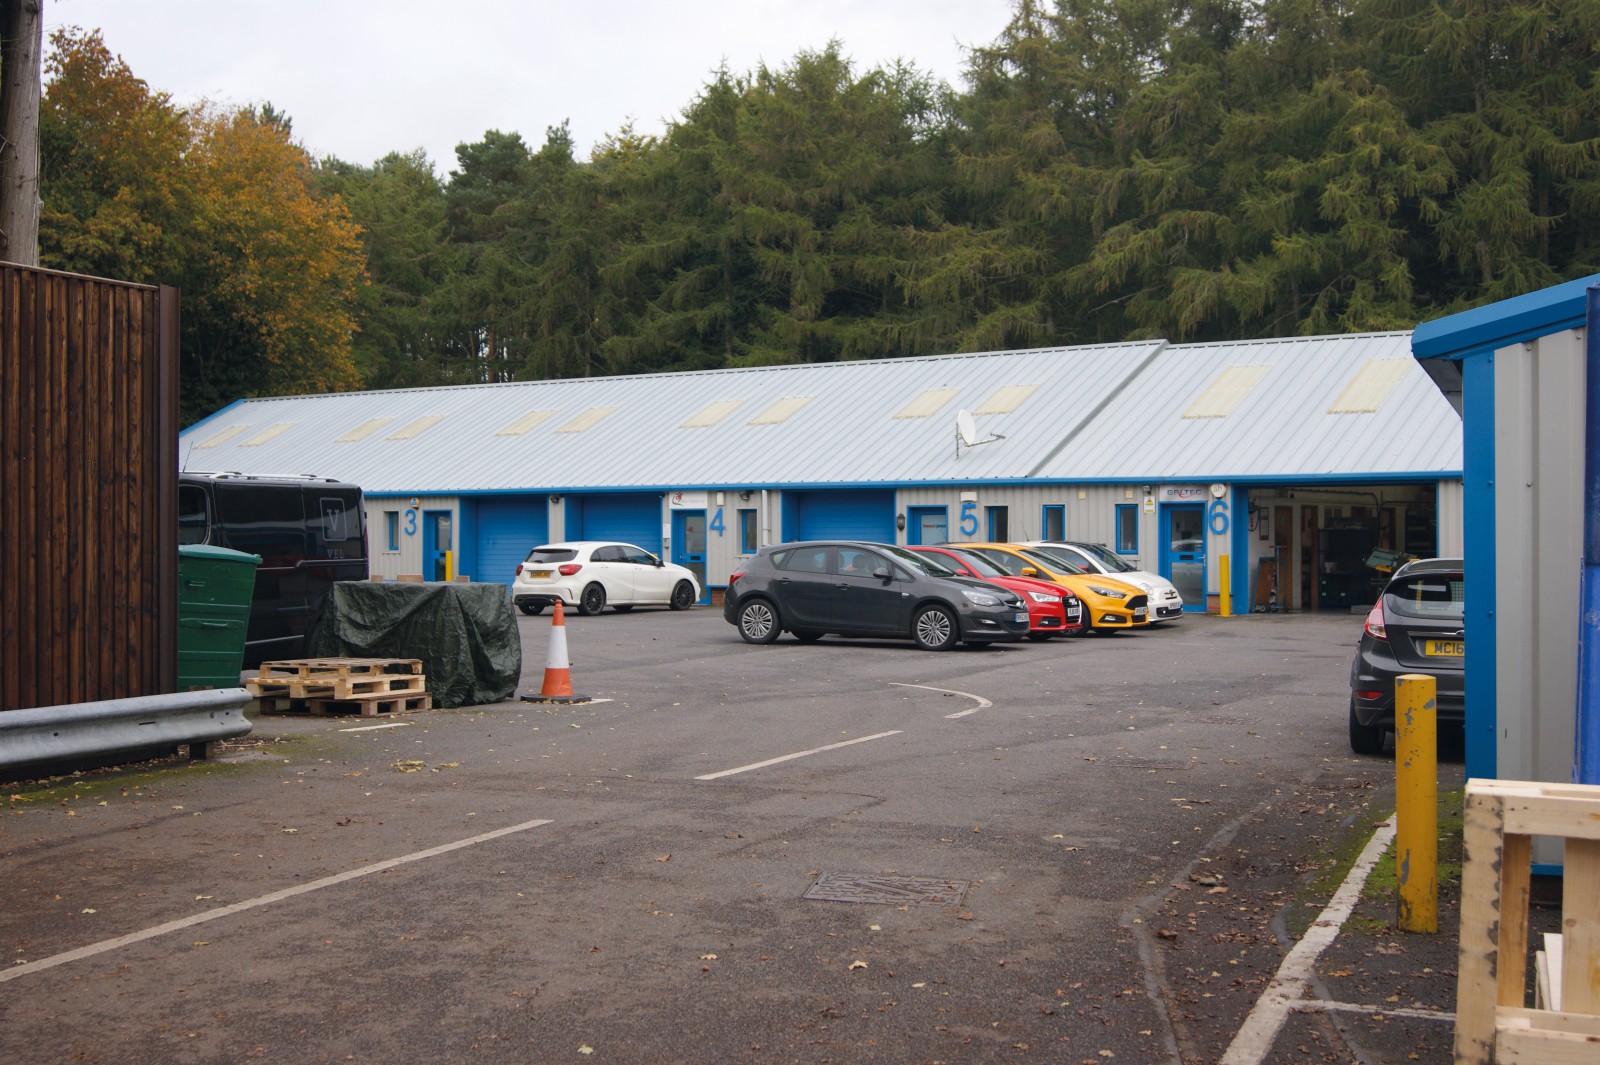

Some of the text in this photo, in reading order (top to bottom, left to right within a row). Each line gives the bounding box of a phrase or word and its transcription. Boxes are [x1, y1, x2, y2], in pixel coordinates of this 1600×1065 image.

[326, 509, 340, 532] V
[404, 509, 417, 536] 3
[709, 507, 726, 537] 4
[960, 503, 978, 536] 5
[1208, 500, 1229, 535] 6
[1434, 641, 1464, 654] MC16
